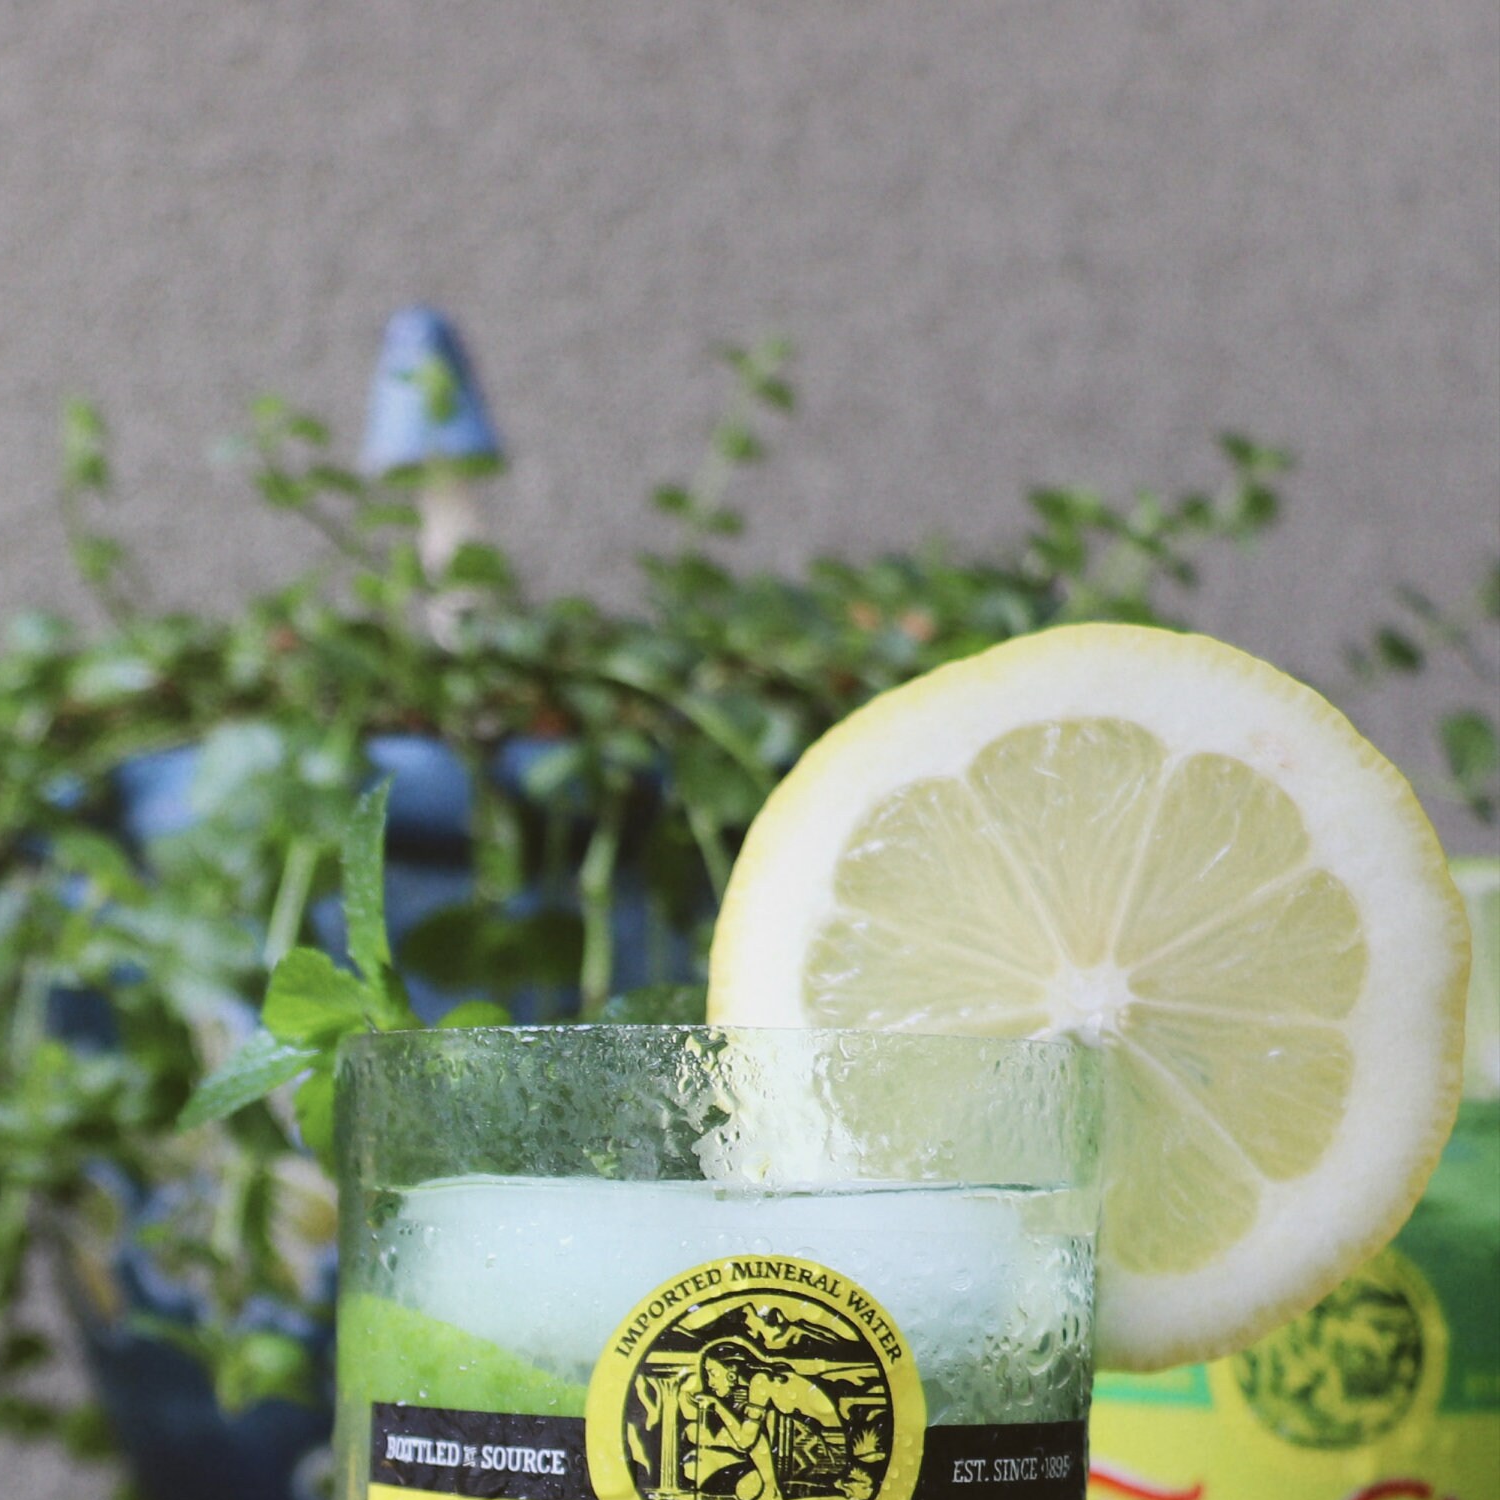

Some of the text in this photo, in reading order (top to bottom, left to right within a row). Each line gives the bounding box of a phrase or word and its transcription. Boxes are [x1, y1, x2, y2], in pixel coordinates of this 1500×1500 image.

[615, 1261, 902, 1364] IMPORTED MINERAL WATER
[386, 1434, 460, 1467] BOTTLED
[481, 1445, 565, 1475] SOURCE
[952, 1458, 989, 1483] EST.
[993, 1457, 1037, 1482] SINCE
